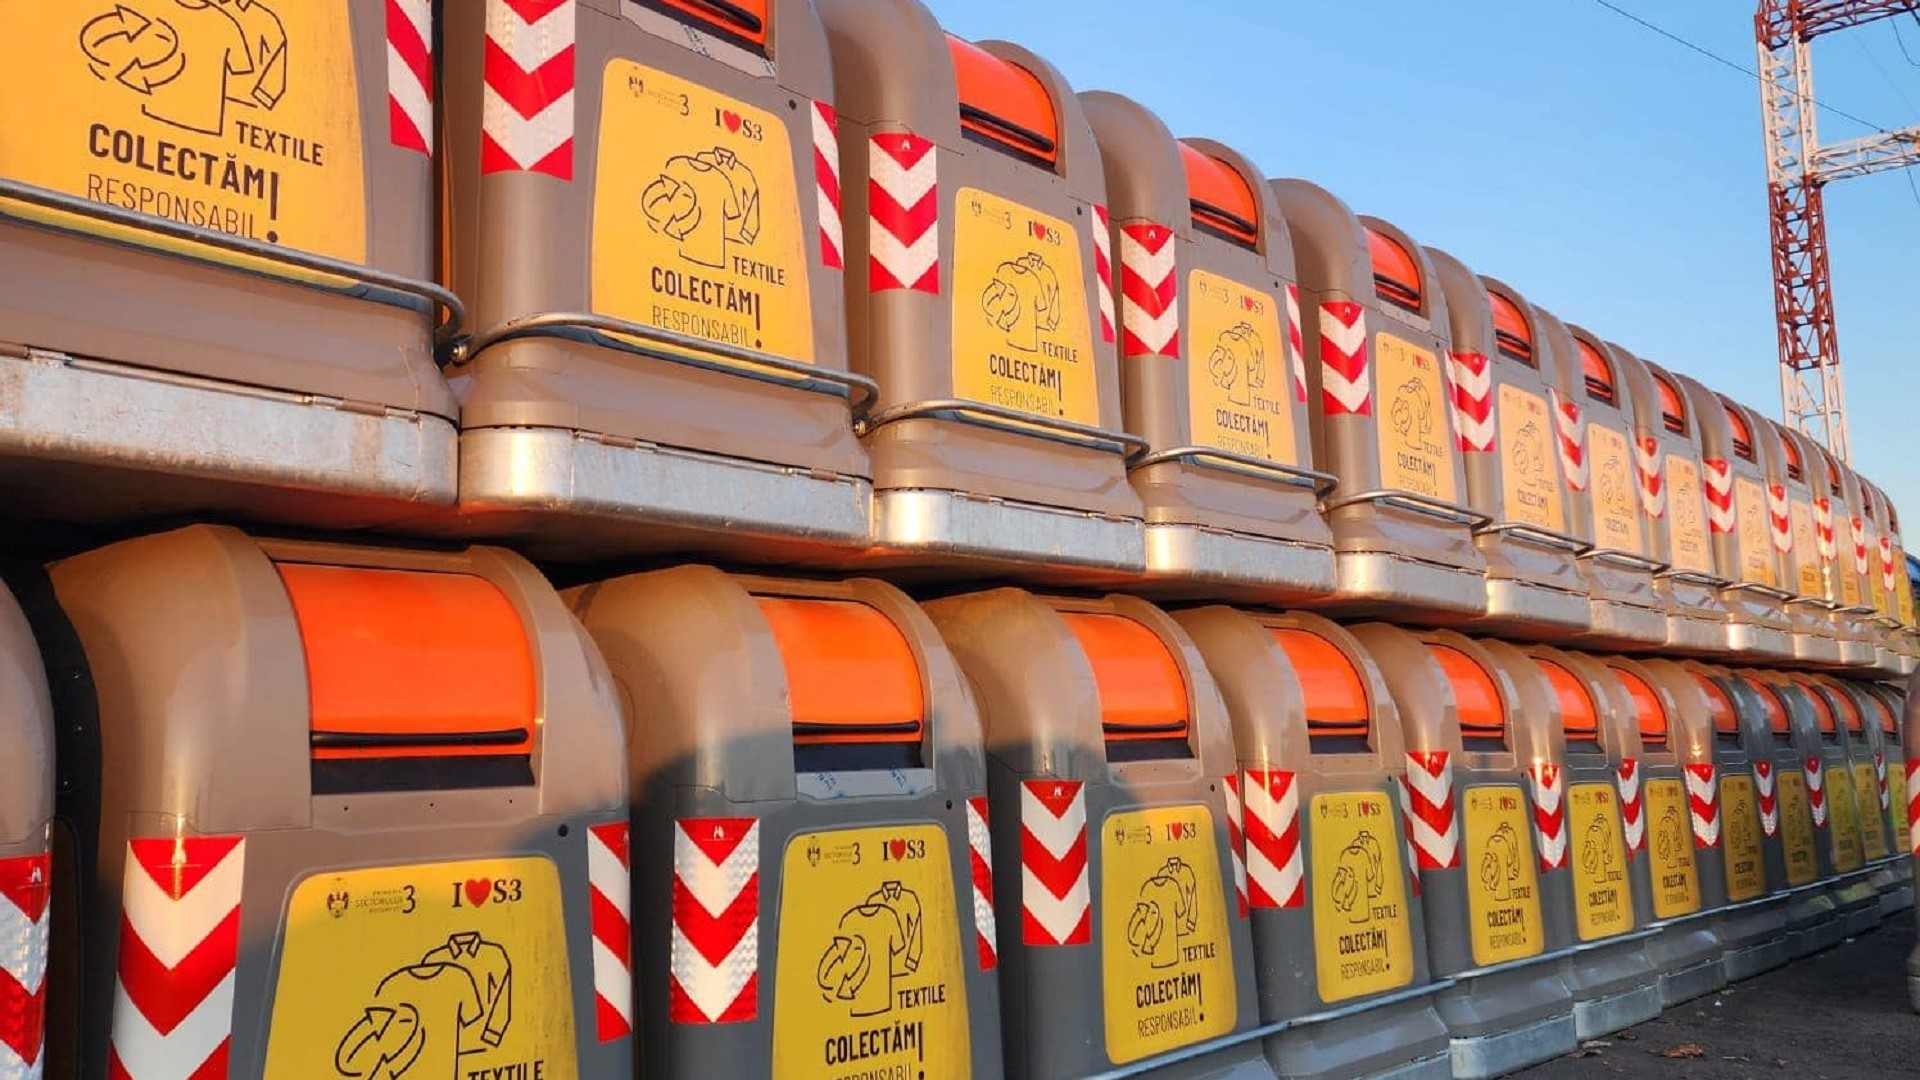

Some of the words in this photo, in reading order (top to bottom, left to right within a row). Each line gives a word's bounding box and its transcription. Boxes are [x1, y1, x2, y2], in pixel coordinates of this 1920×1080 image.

[680, 94, 689, 116] 3
[235, 121, 324, 166] TEXTILE
[88, 173, 261, 241] RESPONSABIL
[732, 255, 785, 286] TEXTILE
[652, 305, 752, 348] RESPONSABIL
[1042, 341, 1078, 363] TEXTILE
[852, 842, 861, 865] 3
[402, 885, 416, 914] 3
[492, 879, 522, 904] S3
[1183, 942, 1215, 963] TEXTILE
[897, 984, 946, 1010] TEXTILE
[1138, 1007, 1197, 1039] RESPONSABIL
